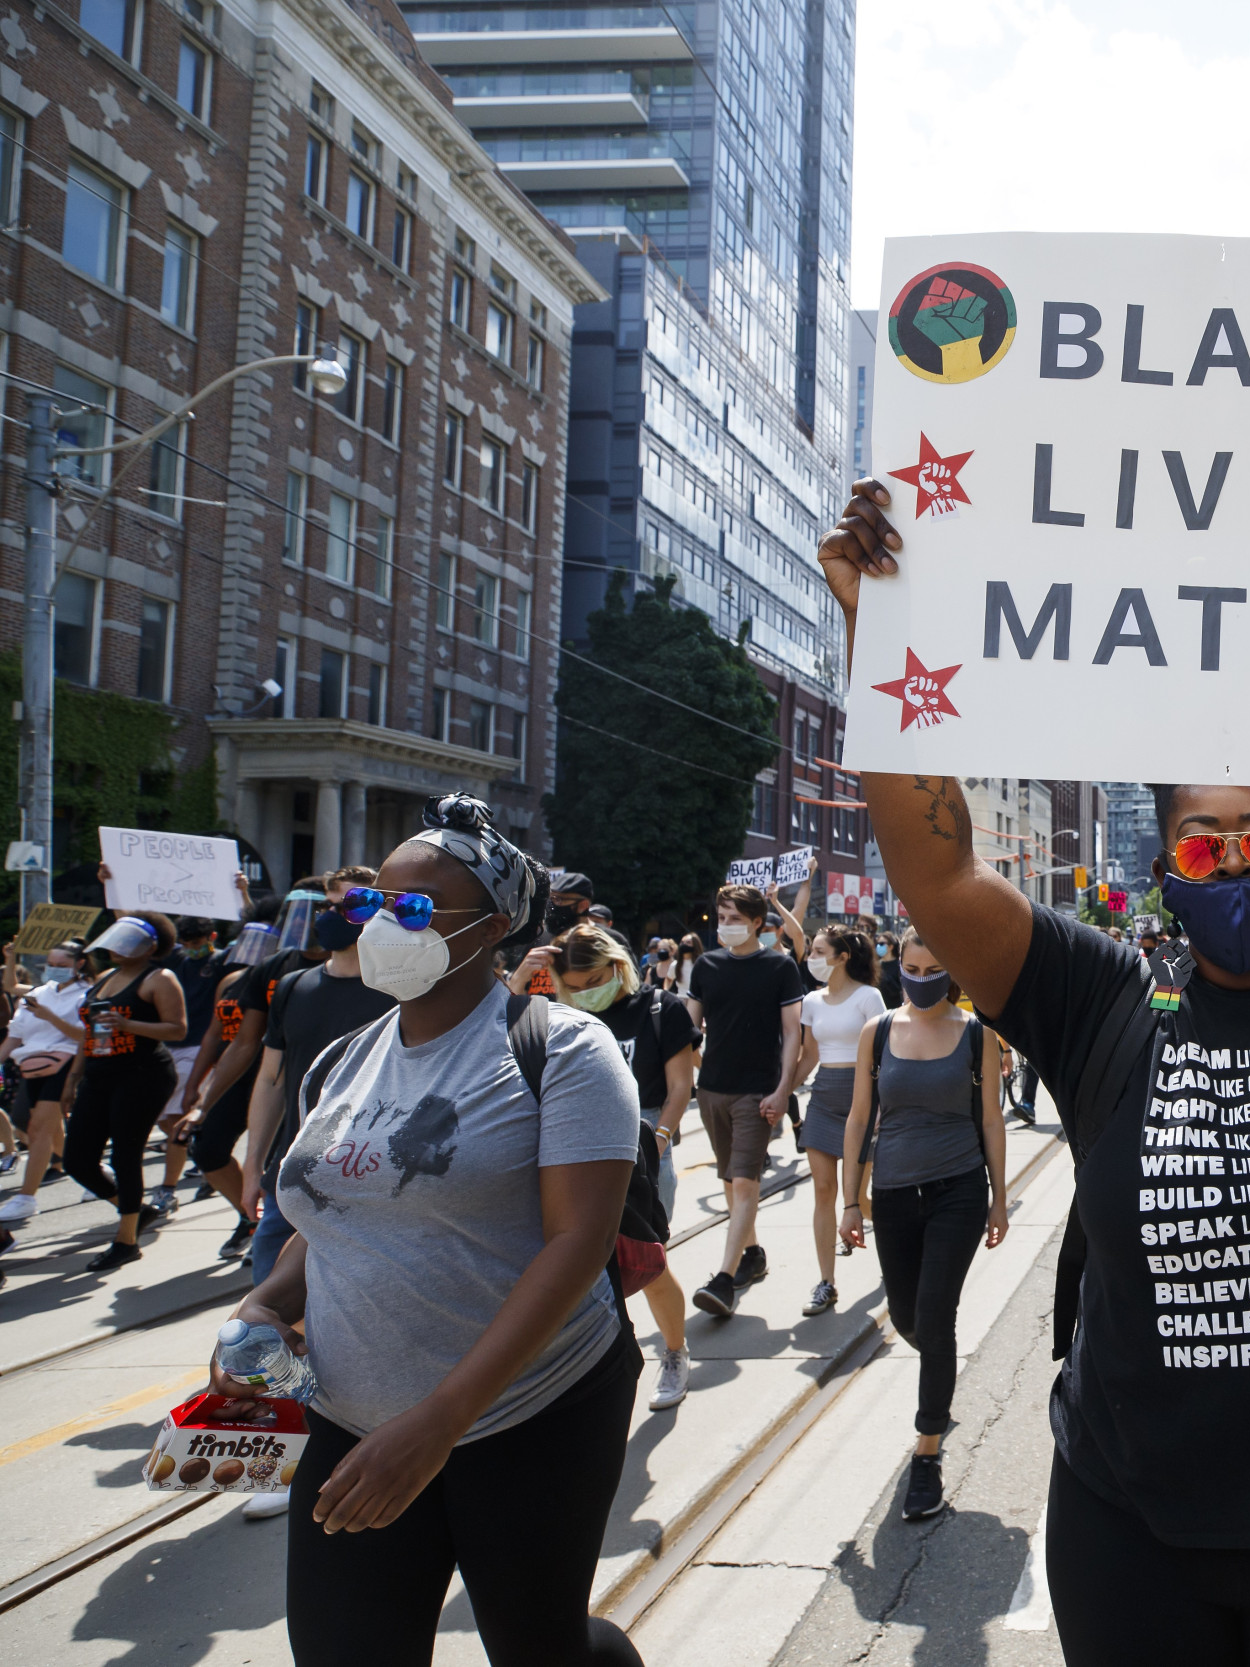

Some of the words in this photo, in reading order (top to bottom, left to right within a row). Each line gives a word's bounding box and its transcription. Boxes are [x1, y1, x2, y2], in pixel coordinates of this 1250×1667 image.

[120, 833, 215, 860] PEOPLE
[779, 849, 809, 866] BLACK
[731, 861, 772, 877] BLACK
[776, 869, 808, 884] MATTER
[780, 861, 804, 875] LIVES
[138, 883, 215, 906] PROFIT
[48, 908, 94, 926] JUSTICE
[531, 976, 552, 986] LIVE
[1162, 1042, 1231, 1069] DREAM
[1156, 1069, 1210, 1092] LEAD
[1214, 1078, 1244, 1098] LIKE
[1149, 1098, 1217, 1122] FIGHT
[1144, 1126, 1220, 1148] THINK
[325, 1140, 382, 1180] Us
[1140, 1155, 1225, 1177] WRITE
[1139, 1187, 1222, 1212] BUILD
[1141, 1216, 1236, 1246] SPEAK
[187, 1433, 287, 1458] timbits
